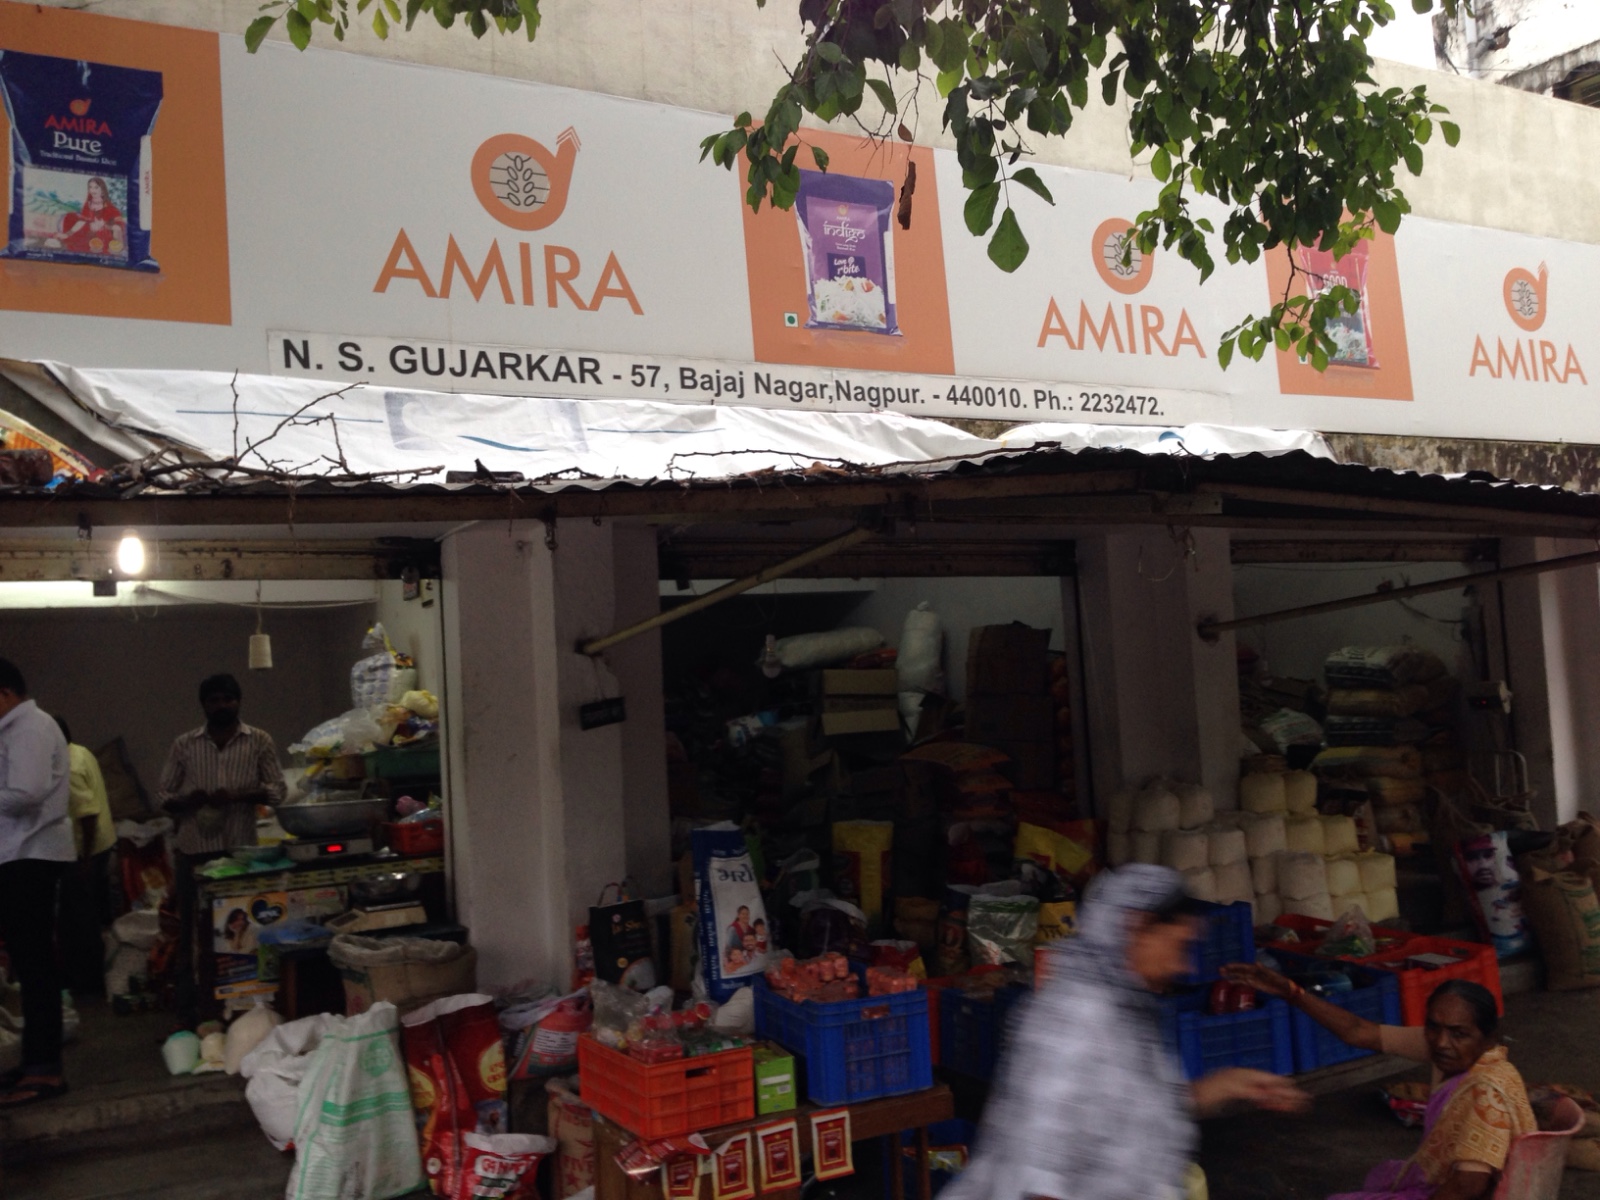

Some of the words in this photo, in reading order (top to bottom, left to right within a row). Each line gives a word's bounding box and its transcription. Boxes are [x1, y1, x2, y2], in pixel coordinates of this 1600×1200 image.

[44, 114, 113, 137] AMIRA
[53, 131, 102, 155] Pure
[372, 227, 645, 316] AMIRA
[1037, 295, 1207, 359] AMIRA
[282, 338, 323, 370] N.
[338, 342, 375, 373] S.
[389, 344, 603, 385] GUJARKAR
[631, 363, 669, 392] 57,
[679, 366, 745, 398] Bajaj
[946, 384, 1027, 409] 440010.
[1079, 391, 1164, 416] 2232472.
[1469, 333, 1588, 386] AMIRA
